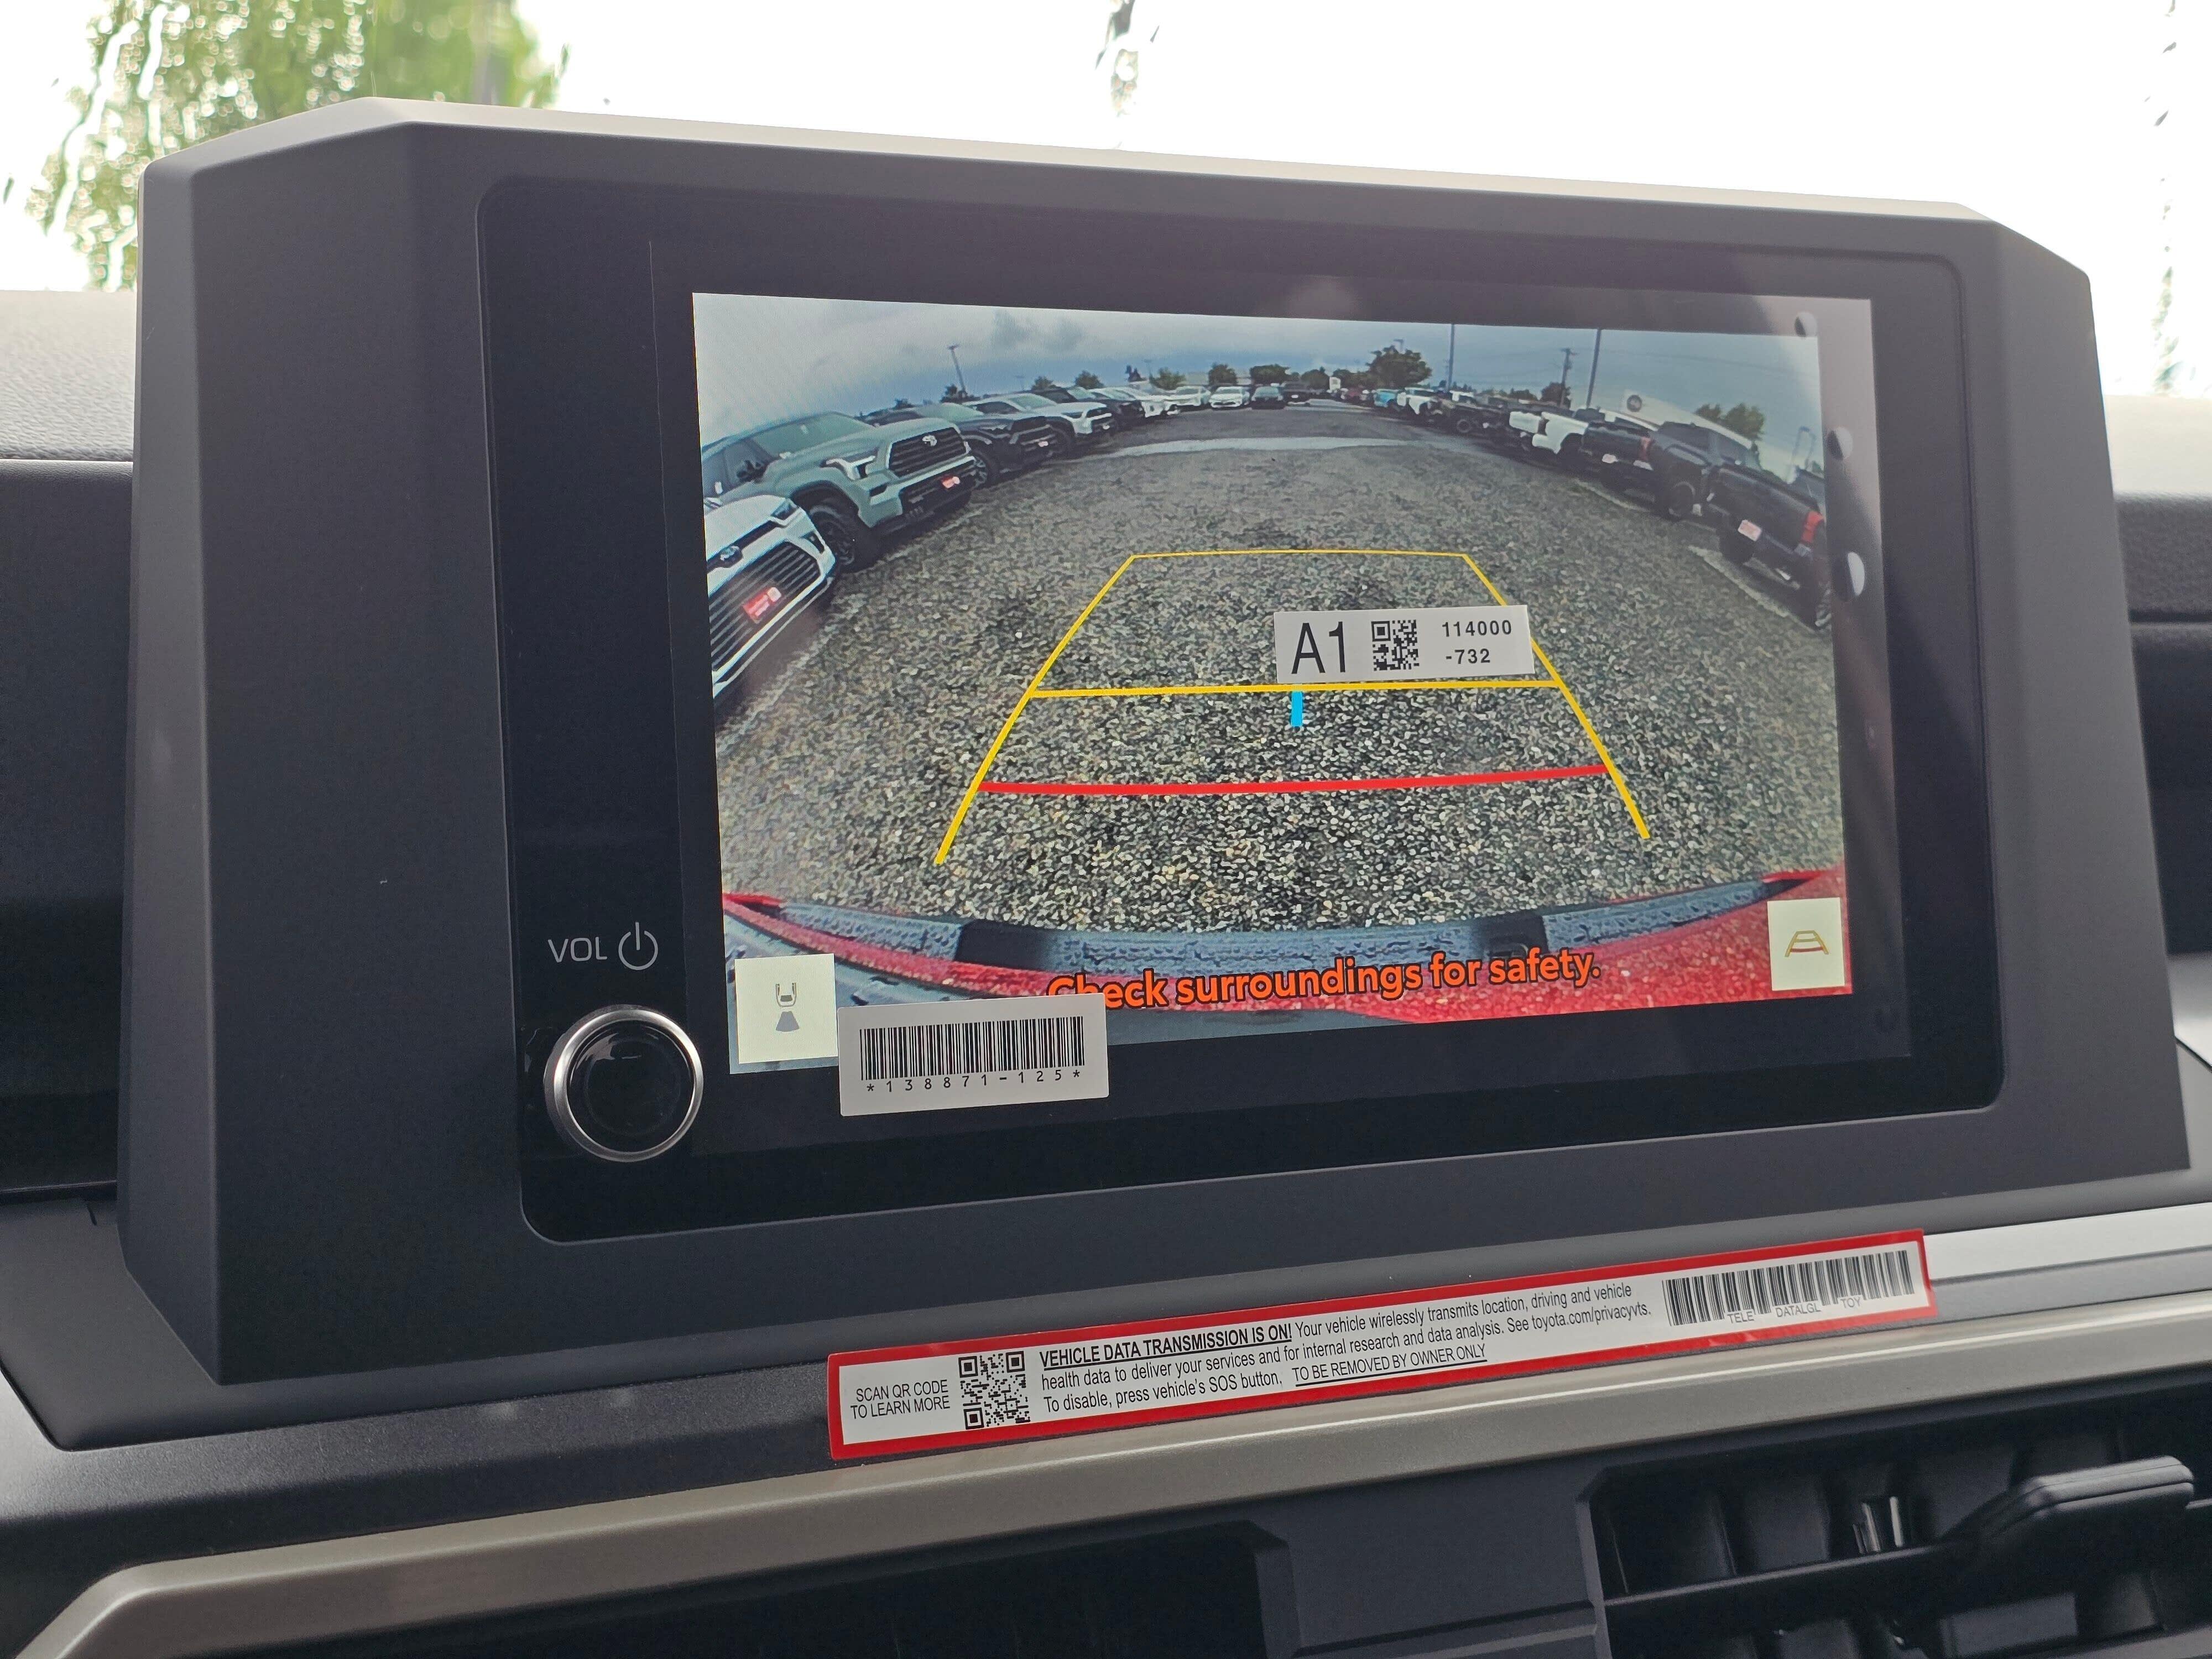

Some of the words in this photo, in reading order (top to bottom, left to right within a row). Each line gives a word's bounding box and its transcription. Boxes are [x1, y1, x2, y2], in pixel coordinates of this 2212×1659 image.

[1442, 620, 1511, 638] 114000
[1291, 621, 1346, 674] A1
[1445, 648, 1490, 665] -732
[547, 936, 608, 963] VOL
[1047, 968, 1168, 1009] Check
[1176, 956, 1423, 1005] surroundings
[1430, 951, 1481, 987] for
[1489, 947, 1601, 988] safety.
[1727, 1311, 1755, 1324] TELE
[1775, 1302, 1821, 1318] DATALGL
[1840, 1296, 1862, 1310] TOY
[1040, 1345, 1100, 1368] VEHICLE
[1104, 1342, 1141, 1360] DATA
[1143, 1328, 1249, 1355] TRANSMISSION
[1253, 1327, 1265, 1343] IS
[1268, 1323, 1292, 1340] ON!
[1295, 1321, 1322, 1338] Your
[1327, 1315, 1366, 1333] vehicle
[1369, 1307, 1424, 1328] wirelessly
[1427, 1301, 1479, 1322] transmits
[1481, 1296, 1528, 1316] location,
[1531, 1290, 1567, 1309] driving
[1571, 1287, 1591, 1304] and
[1594, 1282, 1632, 1300] vehicle
[1041, 1370, 1080, 1391] health
[1083, 1368, 1111, 1386] data
[1114, 1366, 1126, 1382] to
[1131, 1363, 1172, 1380] deliver
[1175, 1360, 1202, 1379] your
[1206, 1352, 1255, 1371] services
[1259, 1346, 1281, 1364] and
[1283, 1345, 1300, 1361] for
[1303, 1338, 1347, 1359] internal
[1349, 1332, 1400, 1353] research
[1403, 1329, 1424, 1346] and
[1427, 1327, 1453, 1343] data
[1455, 1321, 1504, 1340] analysis.
[1507, 1317, 1529, 1333] See
[1531, 1301, 1652, 1332] toyota.com/privacyvts.
[855, 1385, 889, 1402] SCAN
[892, 1383, 910, 1400] QR
[914, 1379, 948, 1395] CODE
[1044, 1396, 1060, 1413] To
[1063, 1392, 1112, 1411] disable,
[1115, 1390, 1150, 1408] press
[1152, 1379, 1206, 1400] vehicle's
[1209, 1374, 1238, 1392] SOS
[1292, 1366, 1309, 1382] TO
[1312, 1364, 1329, 1380] BE
[1331, 1356, 1390, 1376] REMOVED
[1393, 1353, 1408, 1369] BY
[1410, 1347, 1454, 1366] OWNER
[1456, 1343, 1485, 1360] ONLY
[850, 1404, 868, 1420] TO
[871, 1400, 911, 1417] LEARN
[914, 1395, 951, 1411] MORE
